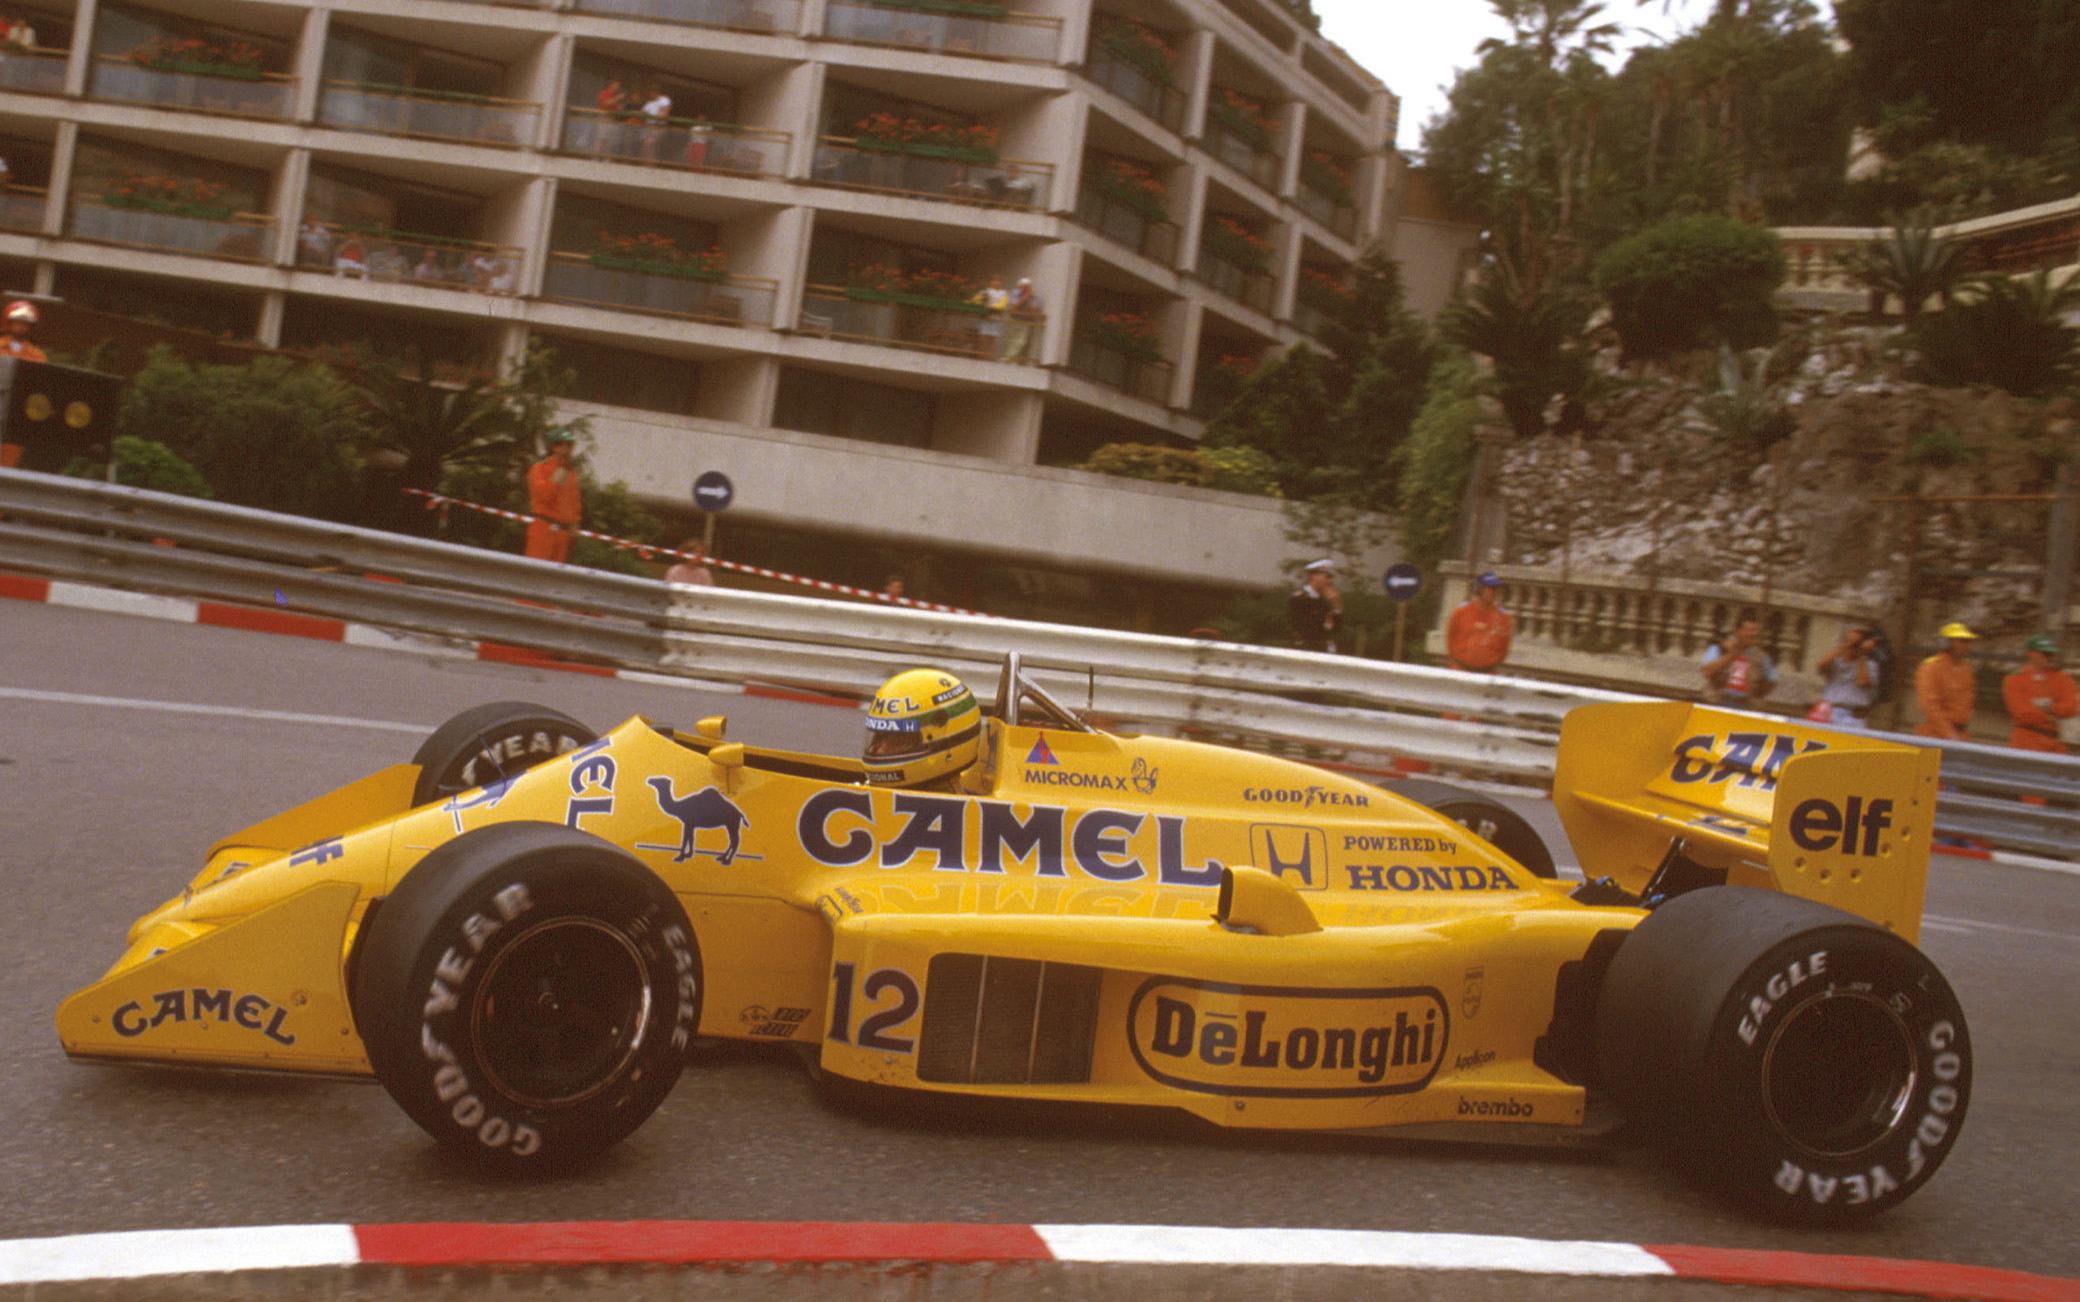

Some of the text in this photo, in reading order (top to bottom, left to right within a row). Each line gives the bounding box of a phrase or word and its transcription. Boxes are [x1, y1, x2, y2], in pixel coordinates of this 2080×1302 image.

[872, 695, 921, 715] MEL
[1024, 769, 1128, 791] MICROMAX
[797, 787, 1224, 888] CAMEL
[1343, 835, 1457, 855] POWERED by
[1789, 795, 1893, 857] elf
[1345, 865, 1519, 891] HONDA
[111, 988, 296, 1046] CAMEL
[826, 960, 922, 1056] 12
[1738, 951, 1828, 1045] EAGLE
[1457, 1096, 1534, 1118] brembo
